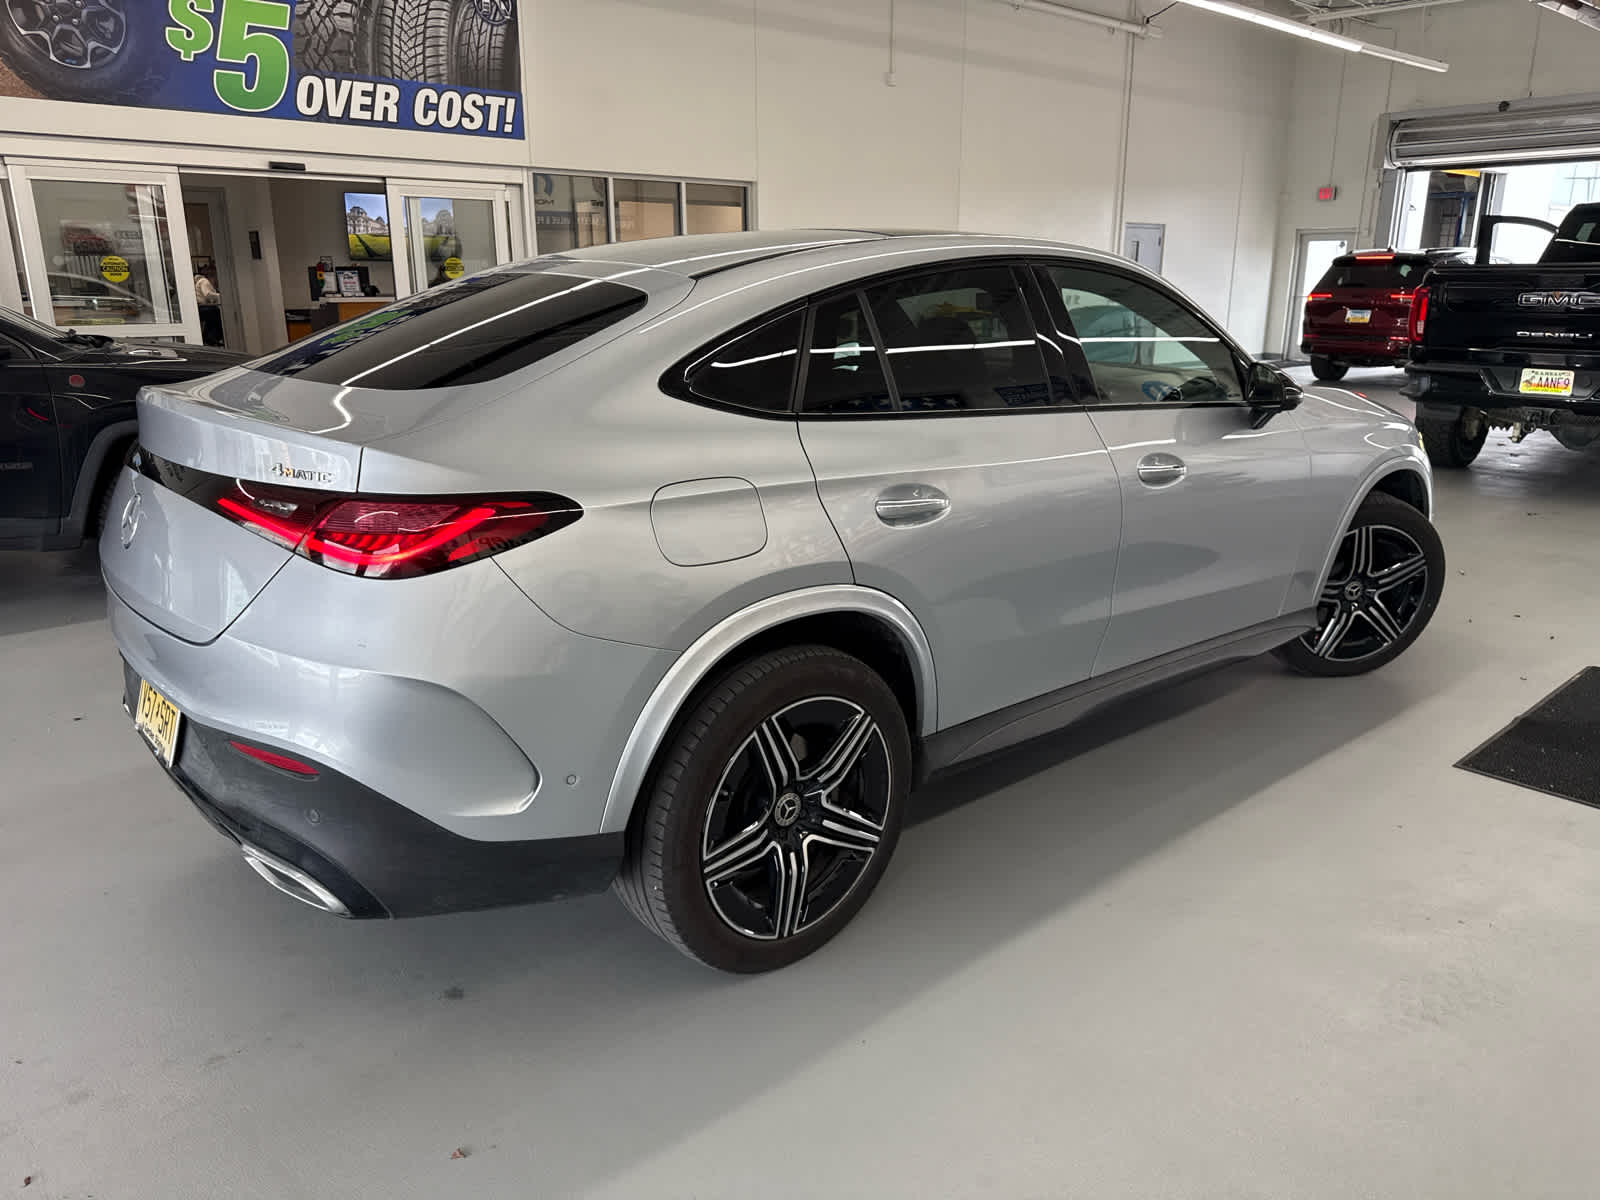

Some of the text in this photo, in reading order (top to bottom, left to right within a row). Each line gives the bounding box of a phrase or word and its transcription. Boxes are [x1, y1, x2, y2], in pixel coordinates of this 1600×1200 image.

[296, 75, 400, 122] OVER
[413, 87, 516, 133] COST!
[1518, 291, 1600, 308] GMC
[1516, 331, 1593, 339] DENALI
[271, 462, 333, 483] 4MATIC
